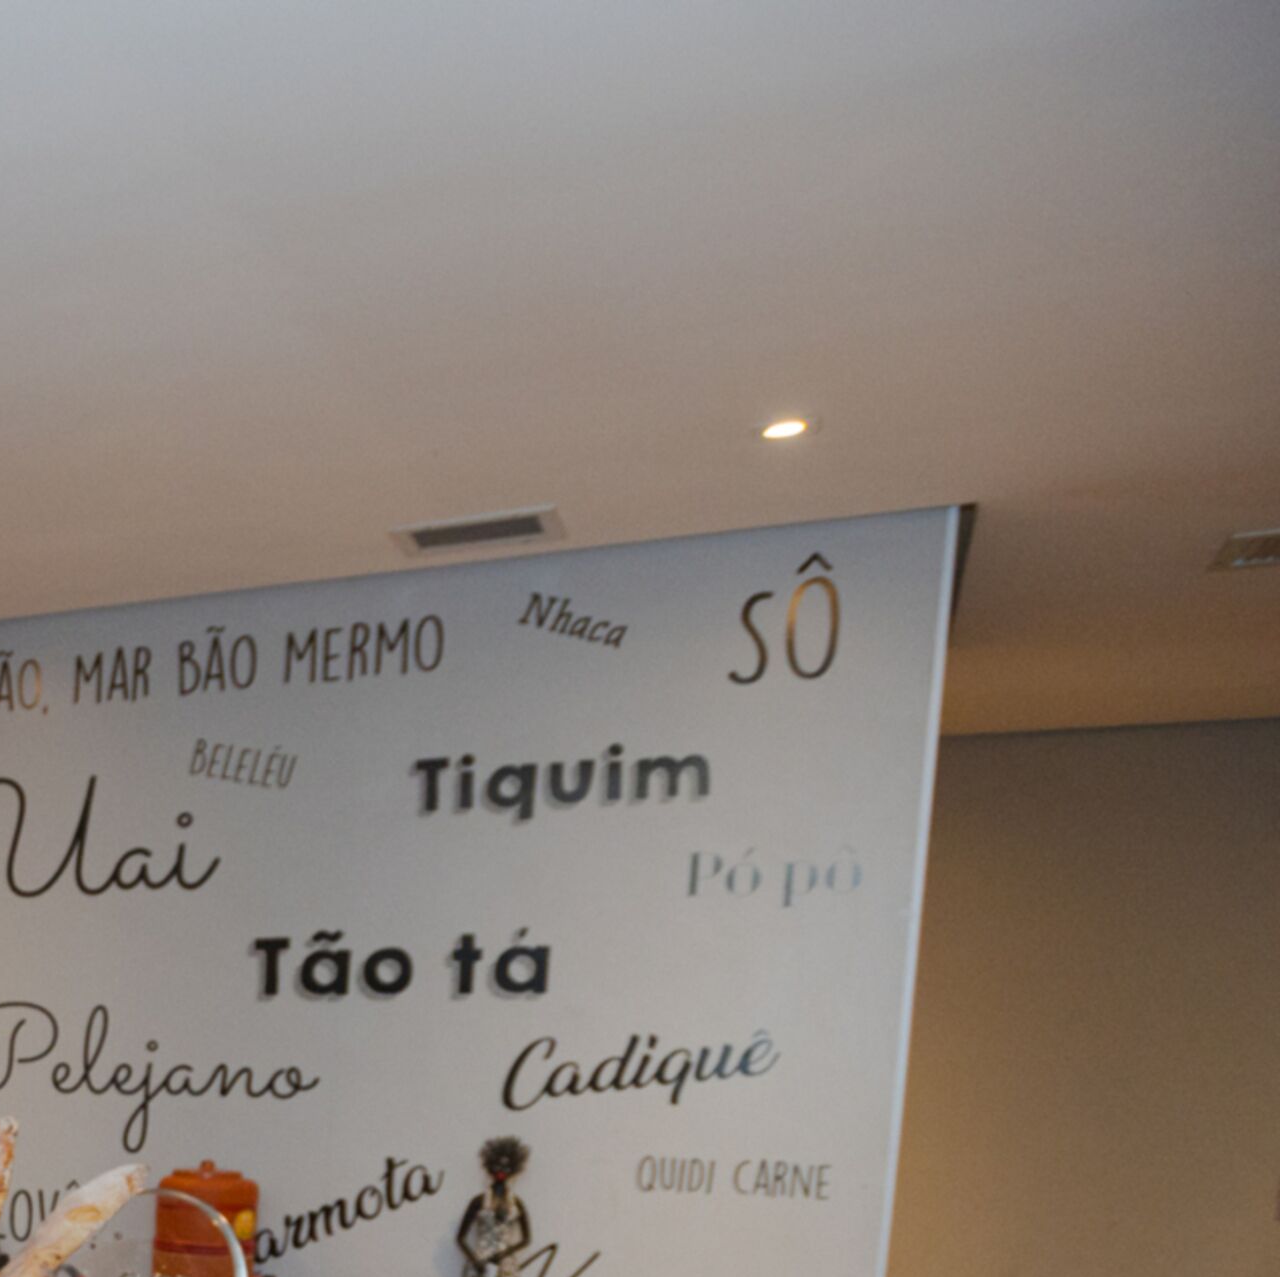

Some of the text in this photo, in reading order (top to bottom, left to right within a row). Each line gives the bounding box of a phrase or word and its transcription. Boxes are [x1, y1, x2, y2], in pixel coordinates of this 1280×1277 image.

[518, 591, 629, 650] Nhaca
[728, 551, 840, 685] SÔ
[73, 646, 153, 705] MAR
[178, 625, 258, 697] BÃO
[283, 614, 446, 686] MERMO
[188, 737, 299, 790] BELELÉU
[410, 742, 712, 822] Tiquim
[687, 845, 763, 898] Pó
[252, 926, 552, 997] Tão tá
[501, 1029, 781, 1112] Cadiquê
[254, 1156, 445, 1264] armota
[637, 1154, 833, 1201] QUIDI CARNE
